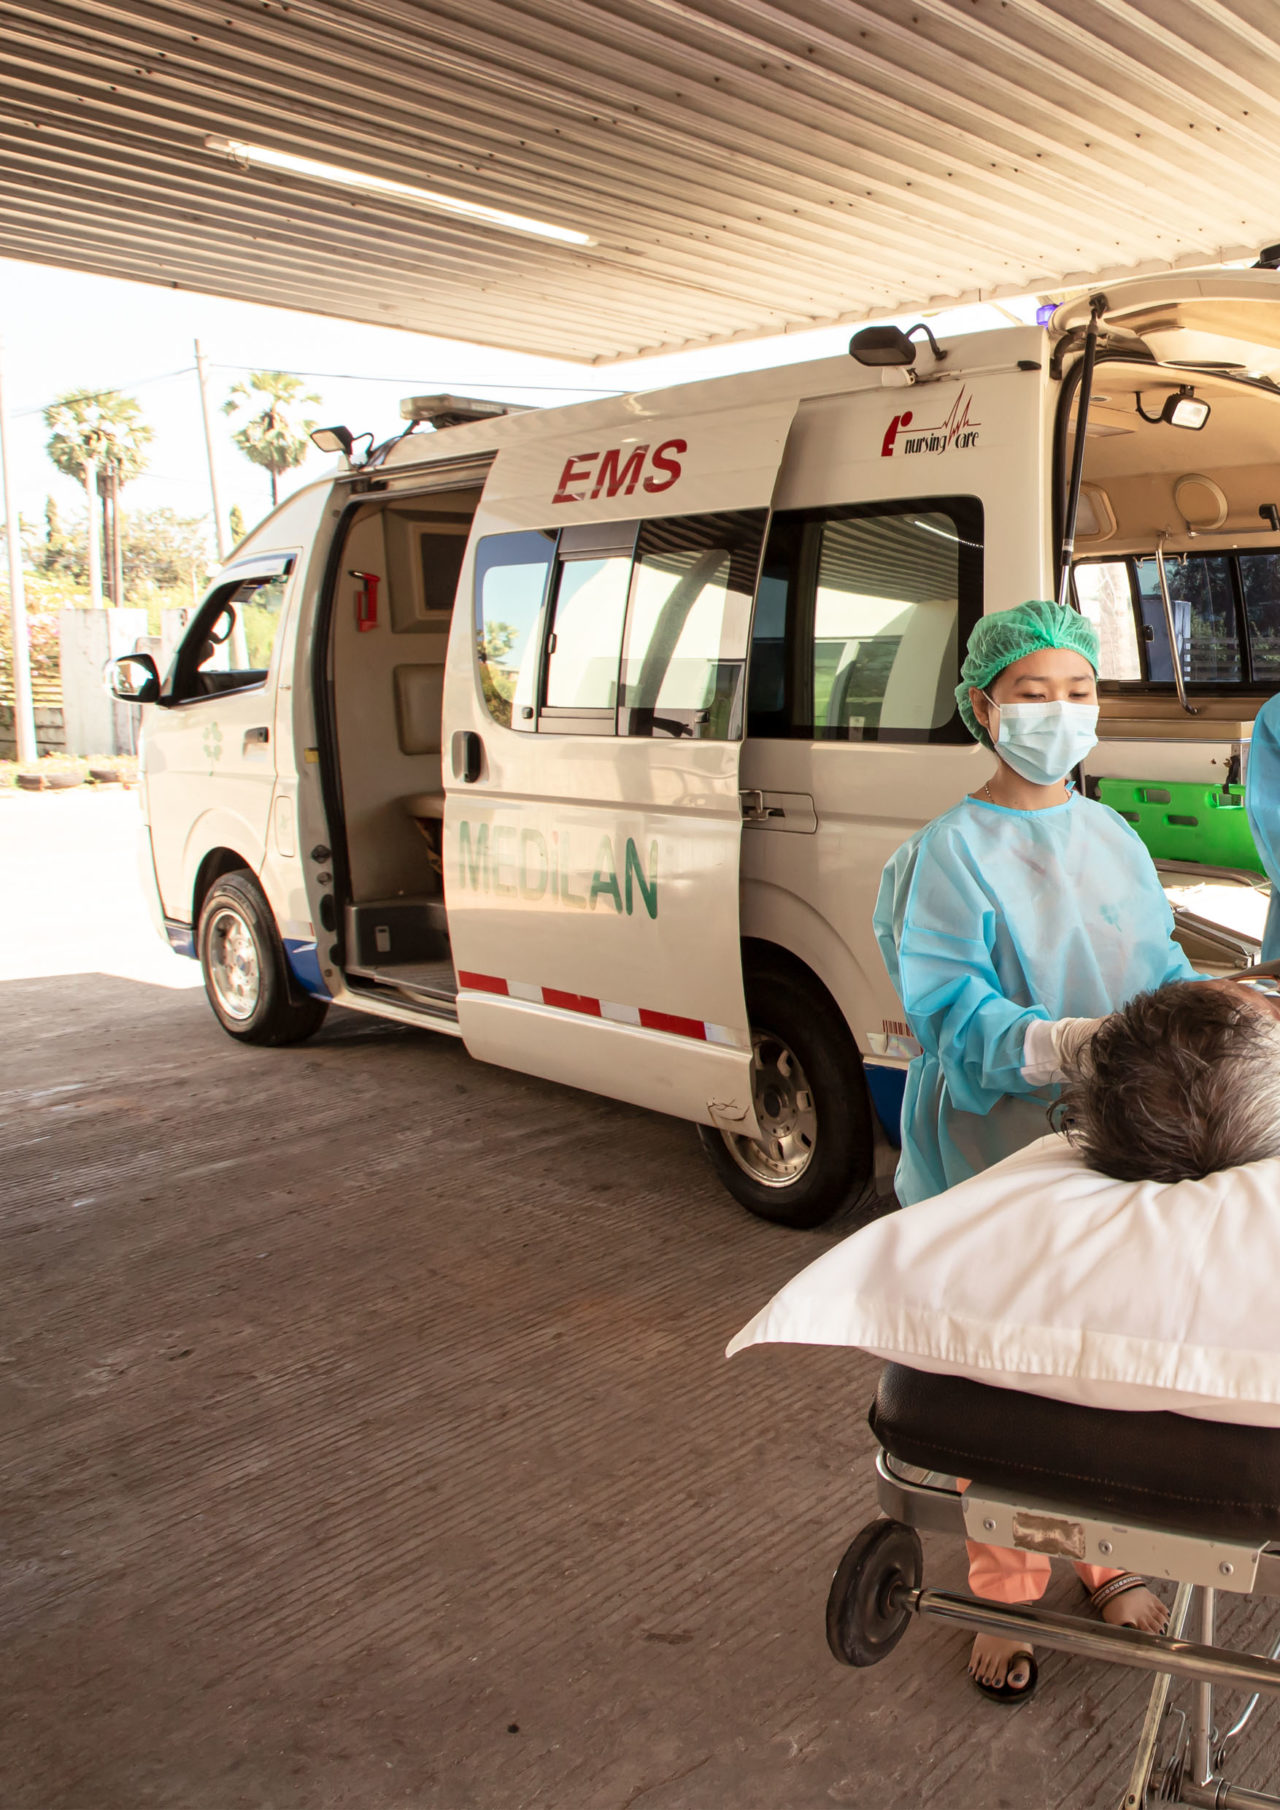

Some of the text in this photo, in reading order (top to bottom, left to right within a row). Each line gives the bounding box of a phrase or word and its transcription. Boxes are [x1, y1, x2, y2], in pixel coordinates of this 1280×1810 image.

[904, 431, 979, 455] nursing care
[551, 438, 688, 504] EMS
